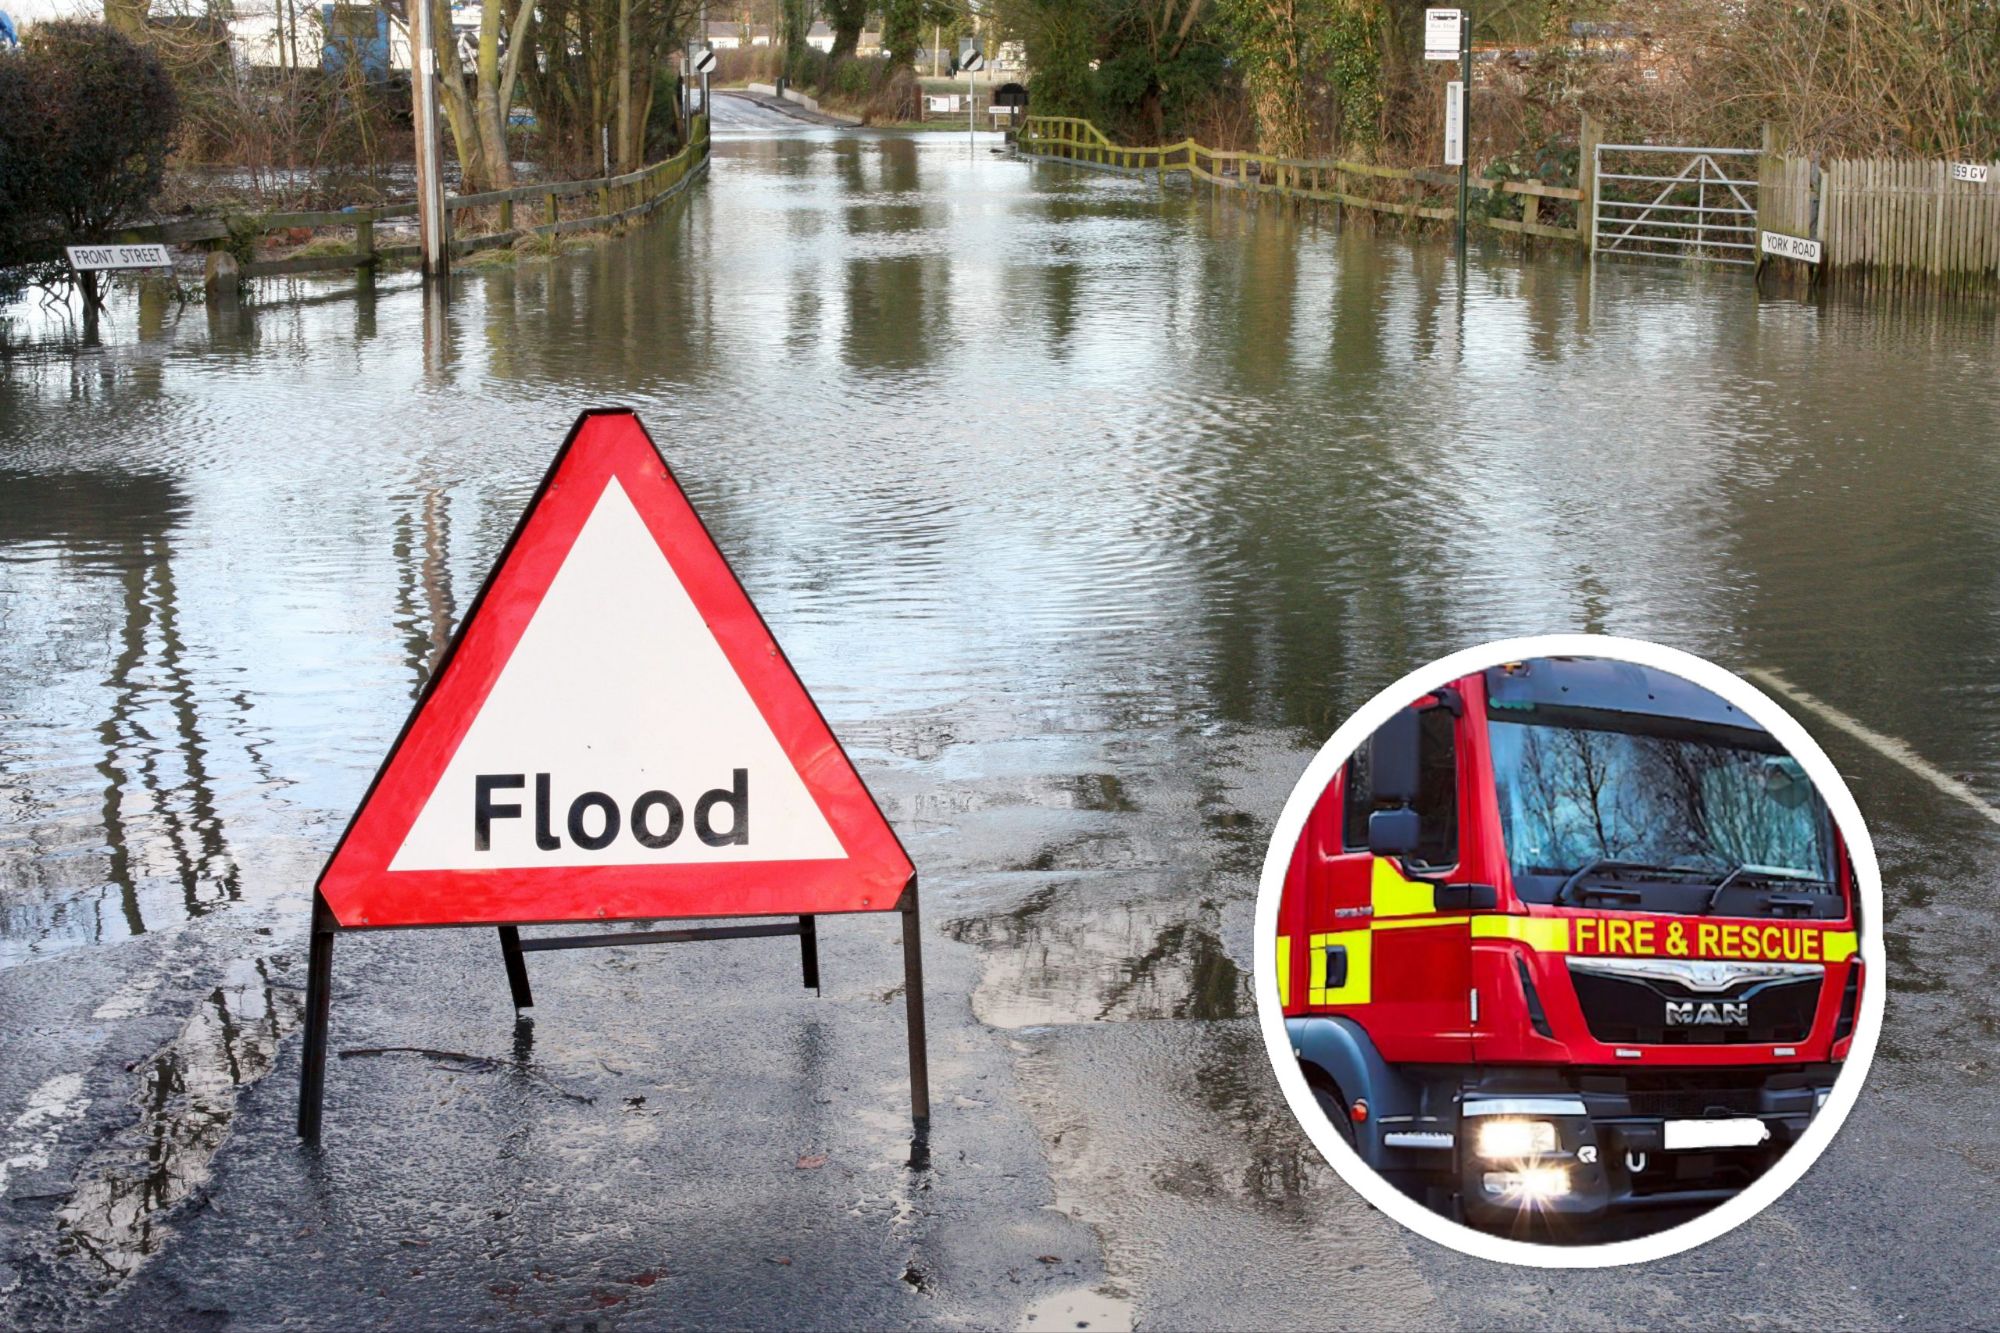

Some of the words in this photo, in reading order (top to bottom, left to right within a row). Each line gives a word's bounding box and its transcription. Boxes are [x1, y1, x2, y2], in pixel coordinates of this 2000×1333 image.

[74, 249, 114, 265] FRONT
[119, 247, 162, 263] STREET
[1767, 234, 1789, 251] YORK
[1792, 240, 1816, 258] ROAD
[474, 767, 749, 851] Flood
[1575, 918, 1655, 955] FIRE
[1665, 921, 1688, 956] &
[1698, 923, 1820, 961] RESCUE
[1665, 1001, 1749, 1026] MAN
